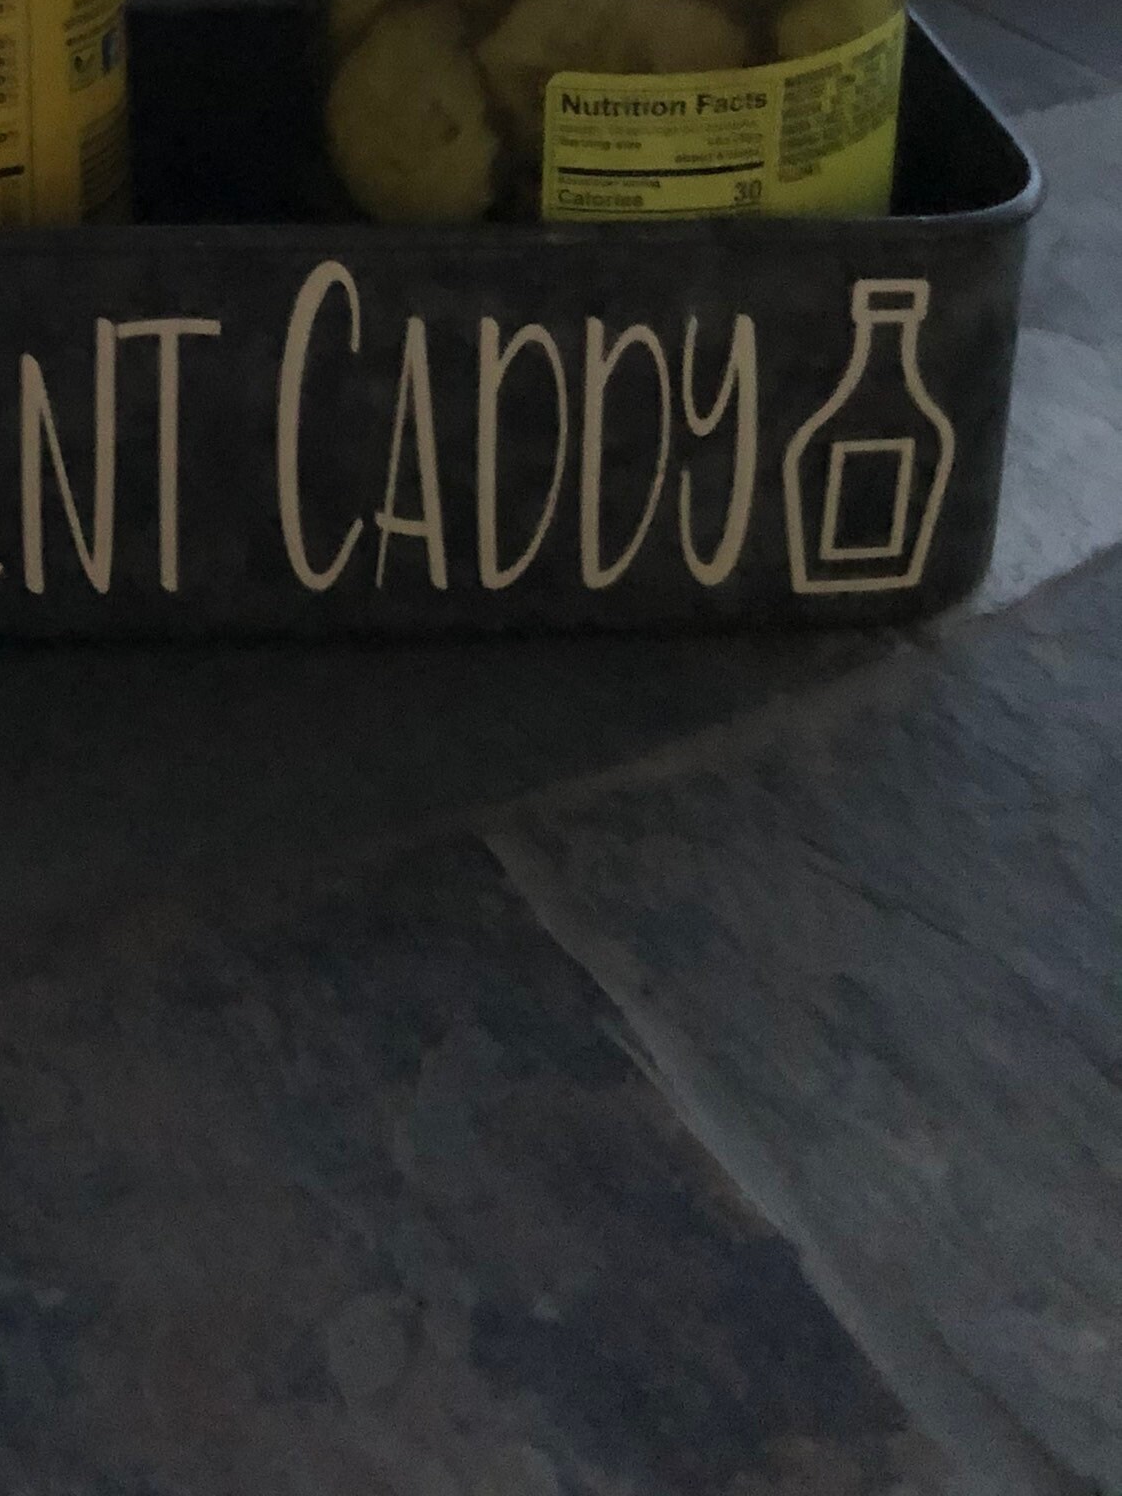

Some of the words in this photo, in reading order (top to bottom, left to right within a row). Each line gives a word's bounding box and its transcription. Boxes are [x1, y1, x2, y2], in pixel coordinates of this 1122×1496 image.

[561, 92, 687, 116] Nutrition
[695, 92, 768, 114] Facts
[558, 188, 644, 207] Calories
[733, 179, 763, 202] 30
[278, 259, 758, 591] CADDY
